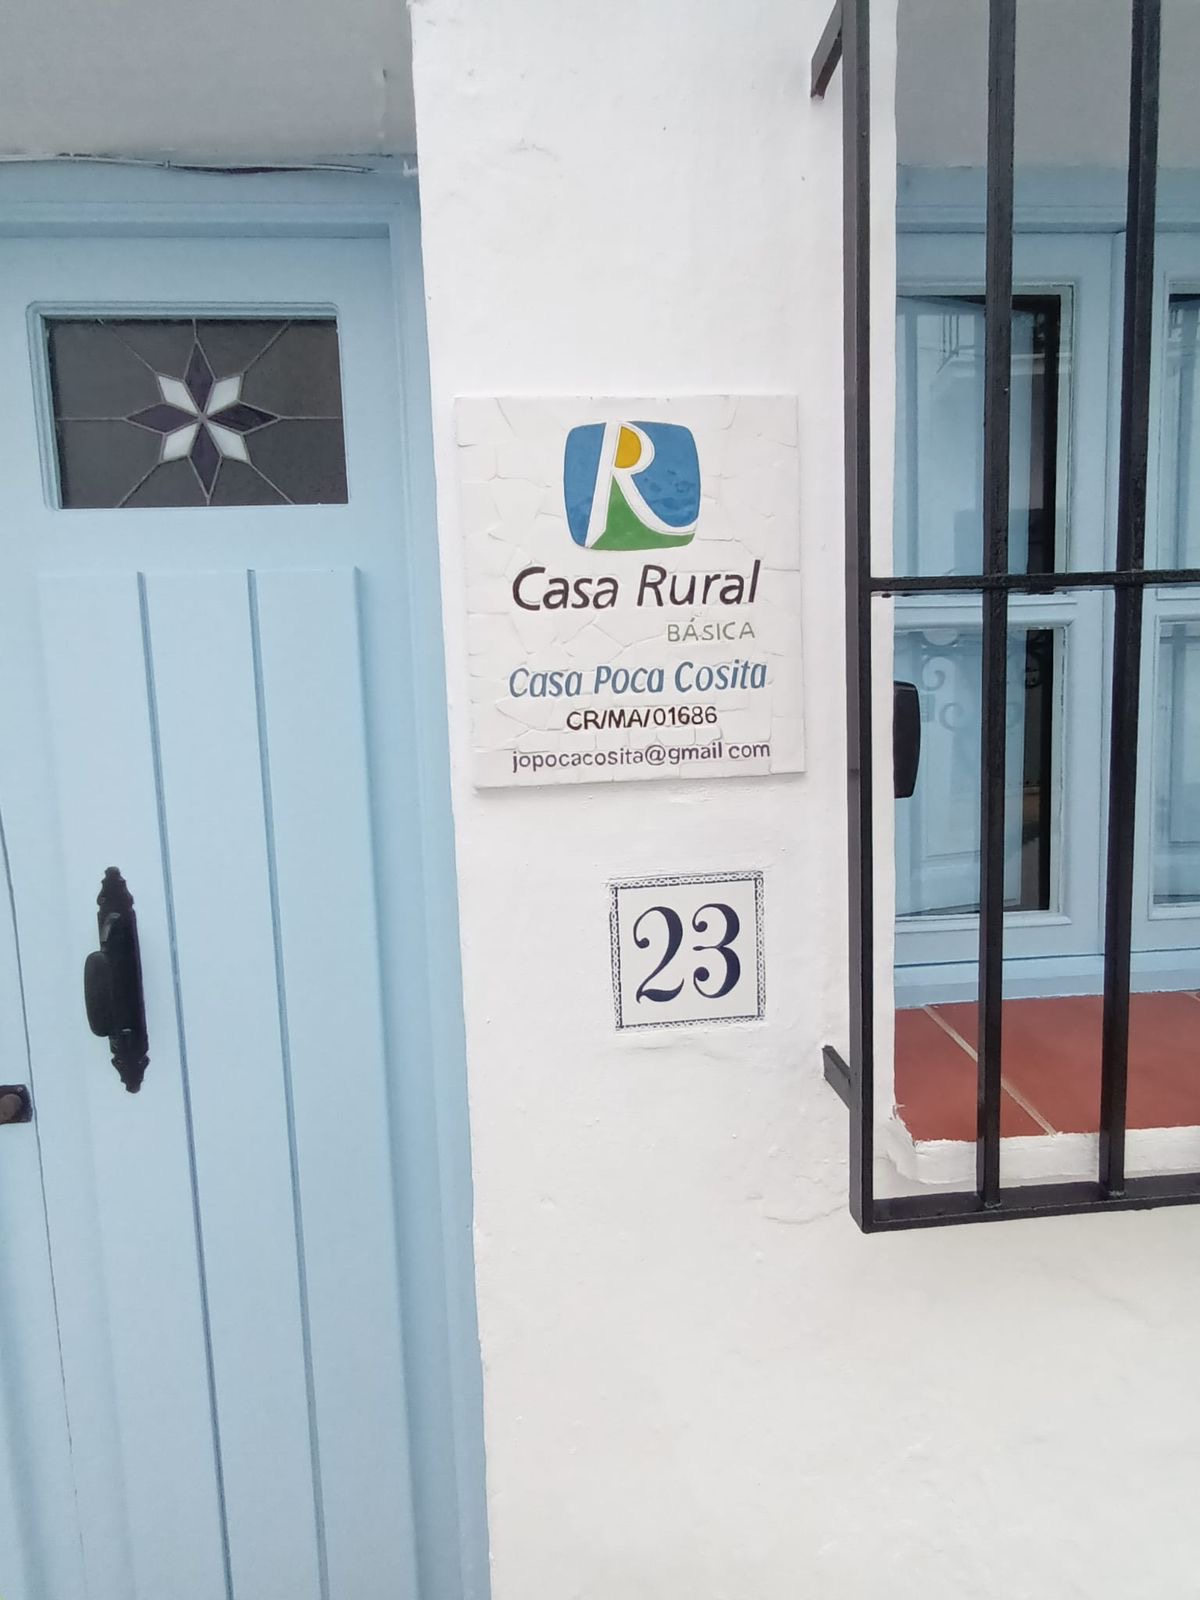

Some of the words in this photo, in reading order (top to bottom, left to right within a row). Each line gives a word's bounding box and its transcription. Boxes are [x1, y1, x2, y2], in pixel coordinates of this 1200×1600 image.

[512, 565, 619, 611] Casa
[637, 559, 761, 608] Rural
[667, 617, 756, 643] BÁSICA
[509, 667, 583, 698] Casa
[594, 665, 665, 695] Poca
[674, 658, 768, 693] Cosita
[566, 706, 718, 731] CR/MA/01686
[633, 903, 741, 1004] 23
